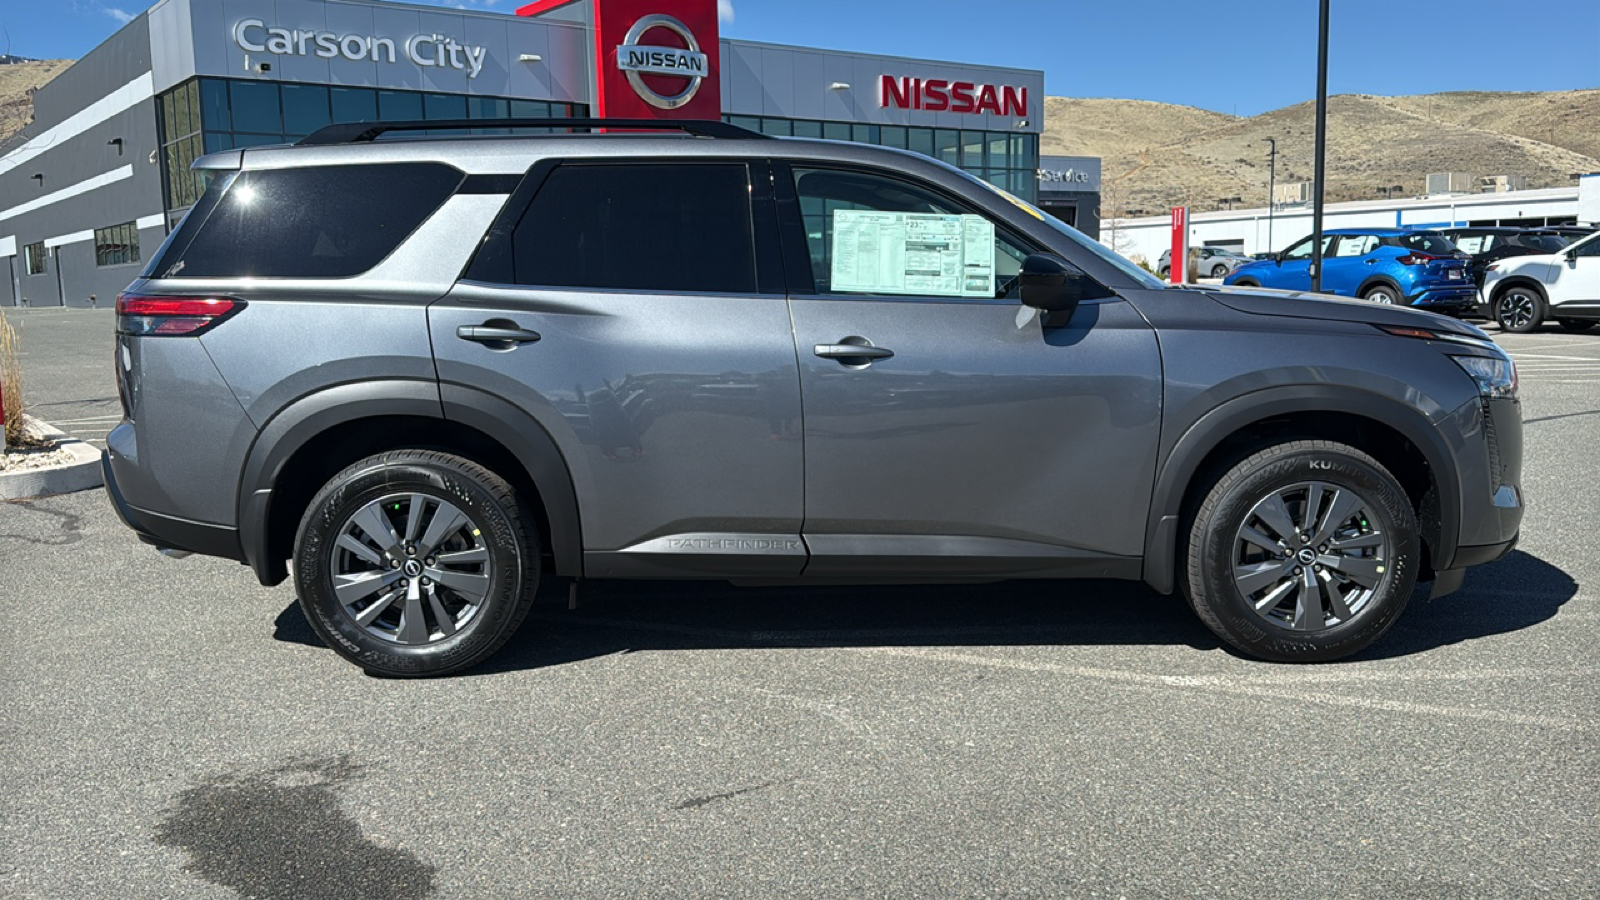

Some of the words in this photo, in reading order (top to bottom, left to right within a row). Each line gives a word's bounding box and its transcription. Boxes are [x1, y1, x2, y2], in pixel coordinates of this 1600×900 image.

[232, 19, 396, 63] Carson
[406, 33, 486, 78] City
[629, 50, 702, 71] NISSAN
[879, 75, 1028, 117] NISSAN
[668, 538, 800, 550] PATHFINDER
